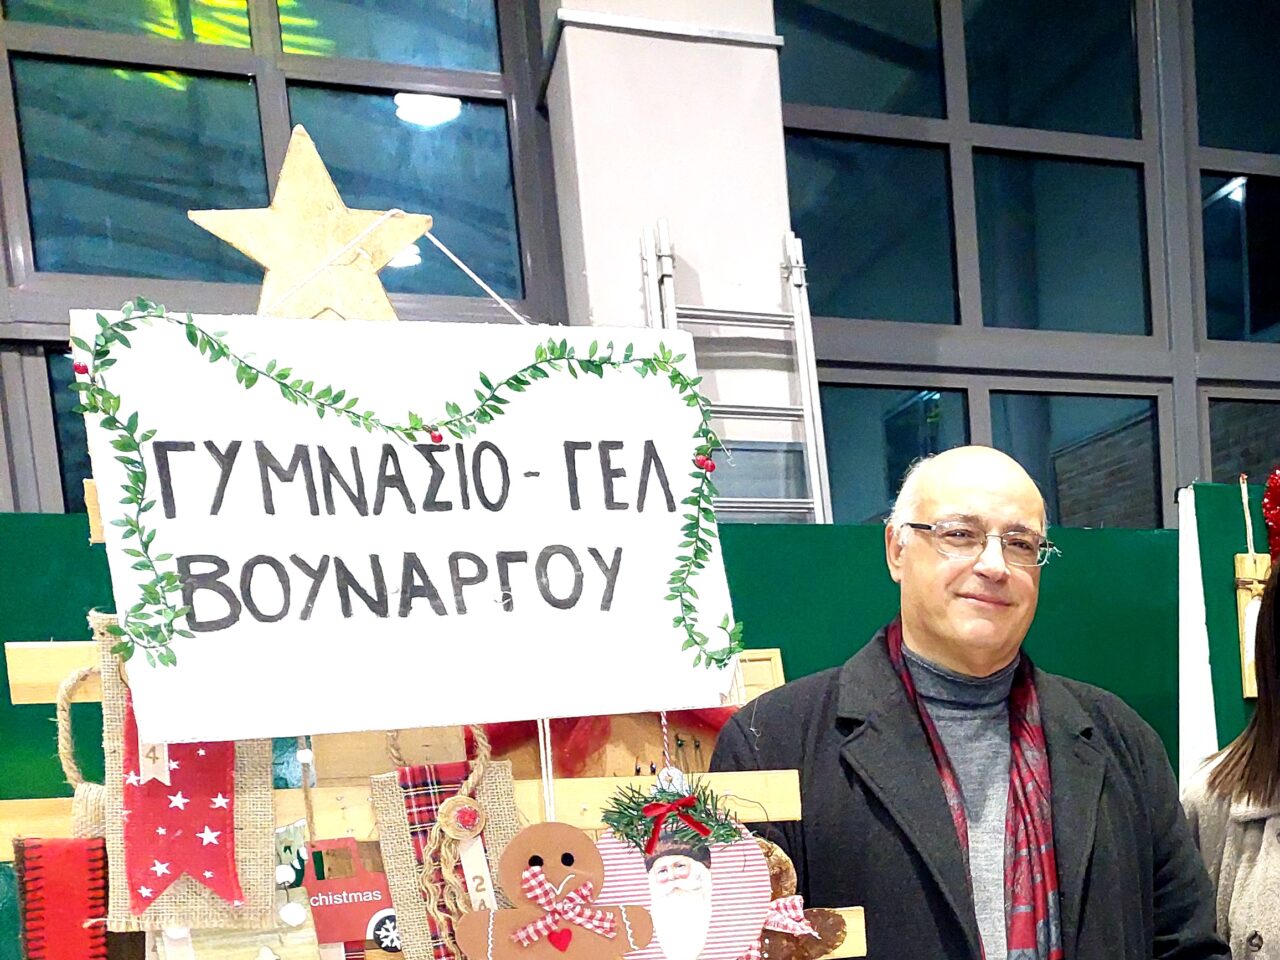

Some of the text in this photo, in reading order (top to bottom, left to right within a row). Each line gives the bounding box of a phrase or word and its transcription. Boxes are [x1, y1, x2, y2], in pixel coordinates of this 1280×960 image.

[153, 440, 511, 520] ΓΥΜΝΑΣΙΟ
[564, 440, 677, 513] ΓΕΛ
[177, 545, 623, 633] ΒΟΥΝΑΡΓΟΥ
[310, 890, 382, 907] chistmas
